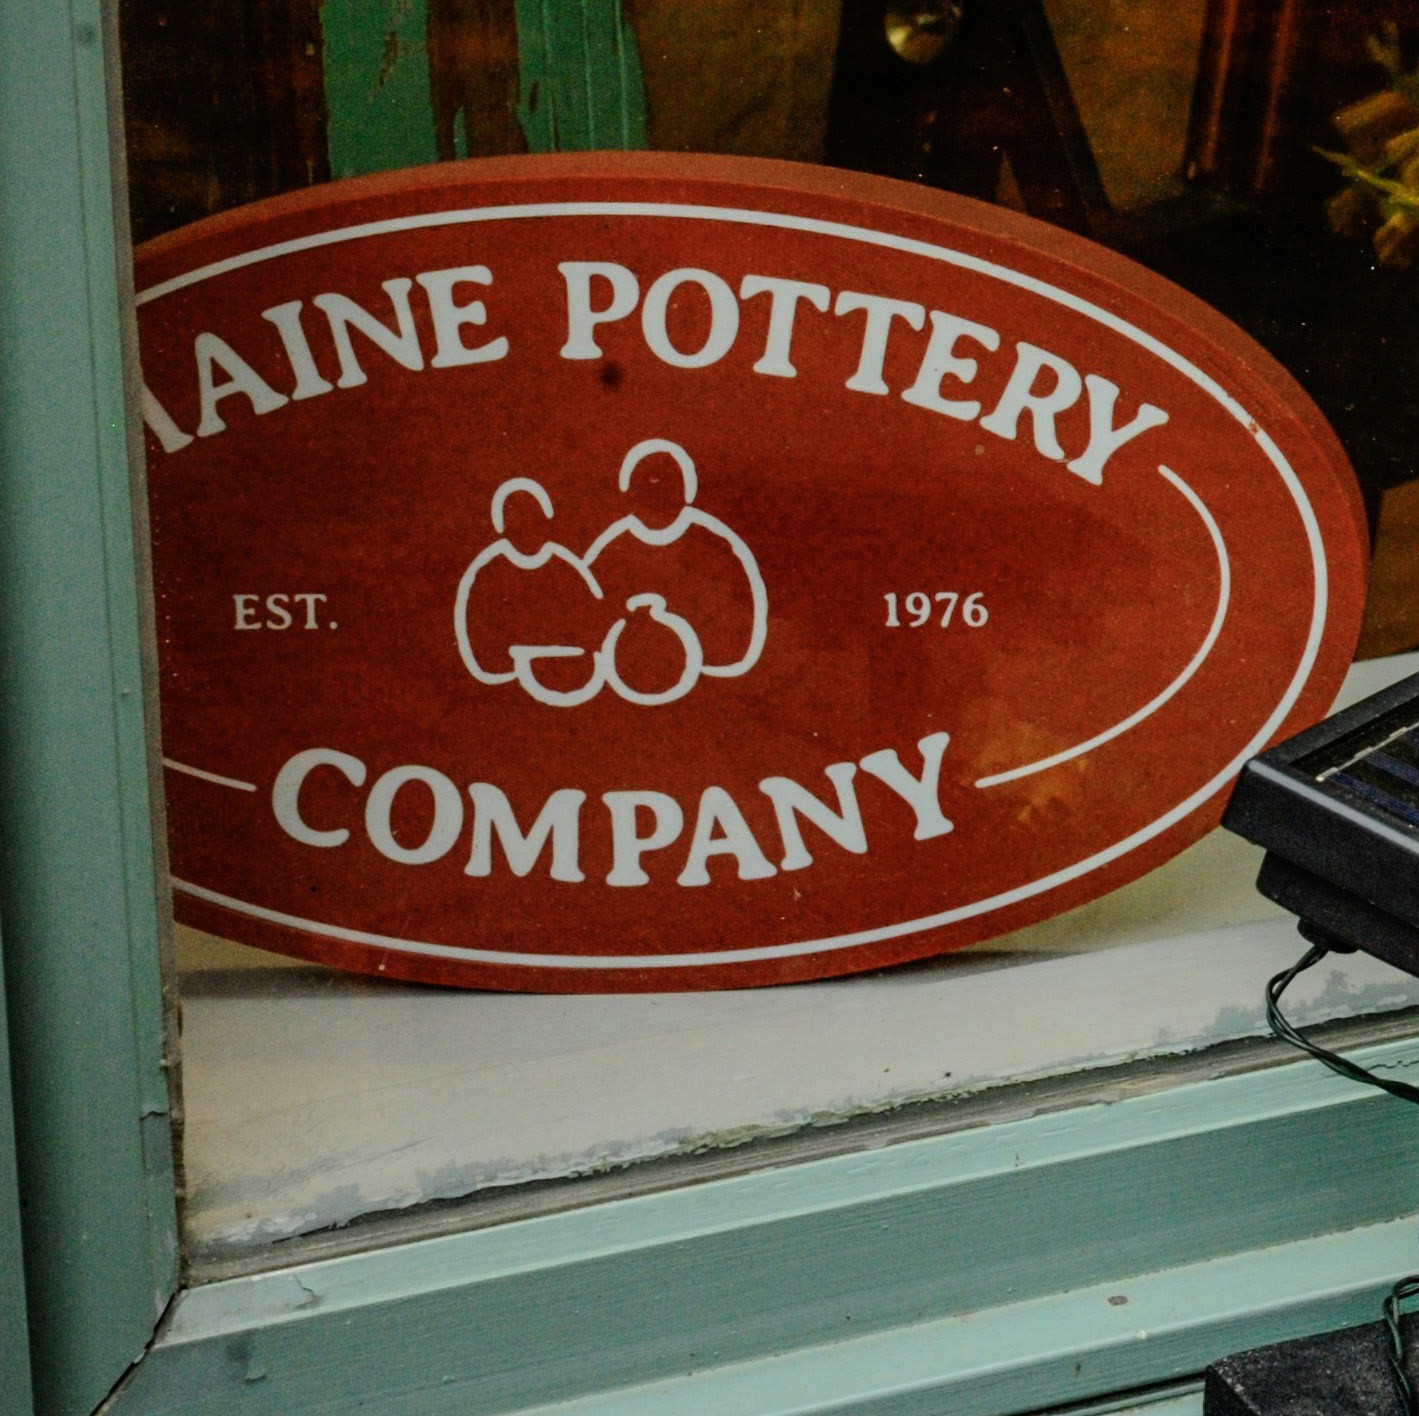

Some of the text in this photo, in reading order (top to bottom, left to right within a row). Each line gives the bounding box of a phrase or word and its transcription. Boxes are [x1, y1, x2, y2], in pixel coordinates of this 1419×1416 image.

[141, 260, 1170, 486] AINE POTTERY
[233, 591, 990, 630] EST. 1976
[272, 731, 954, 888] COMPANY
